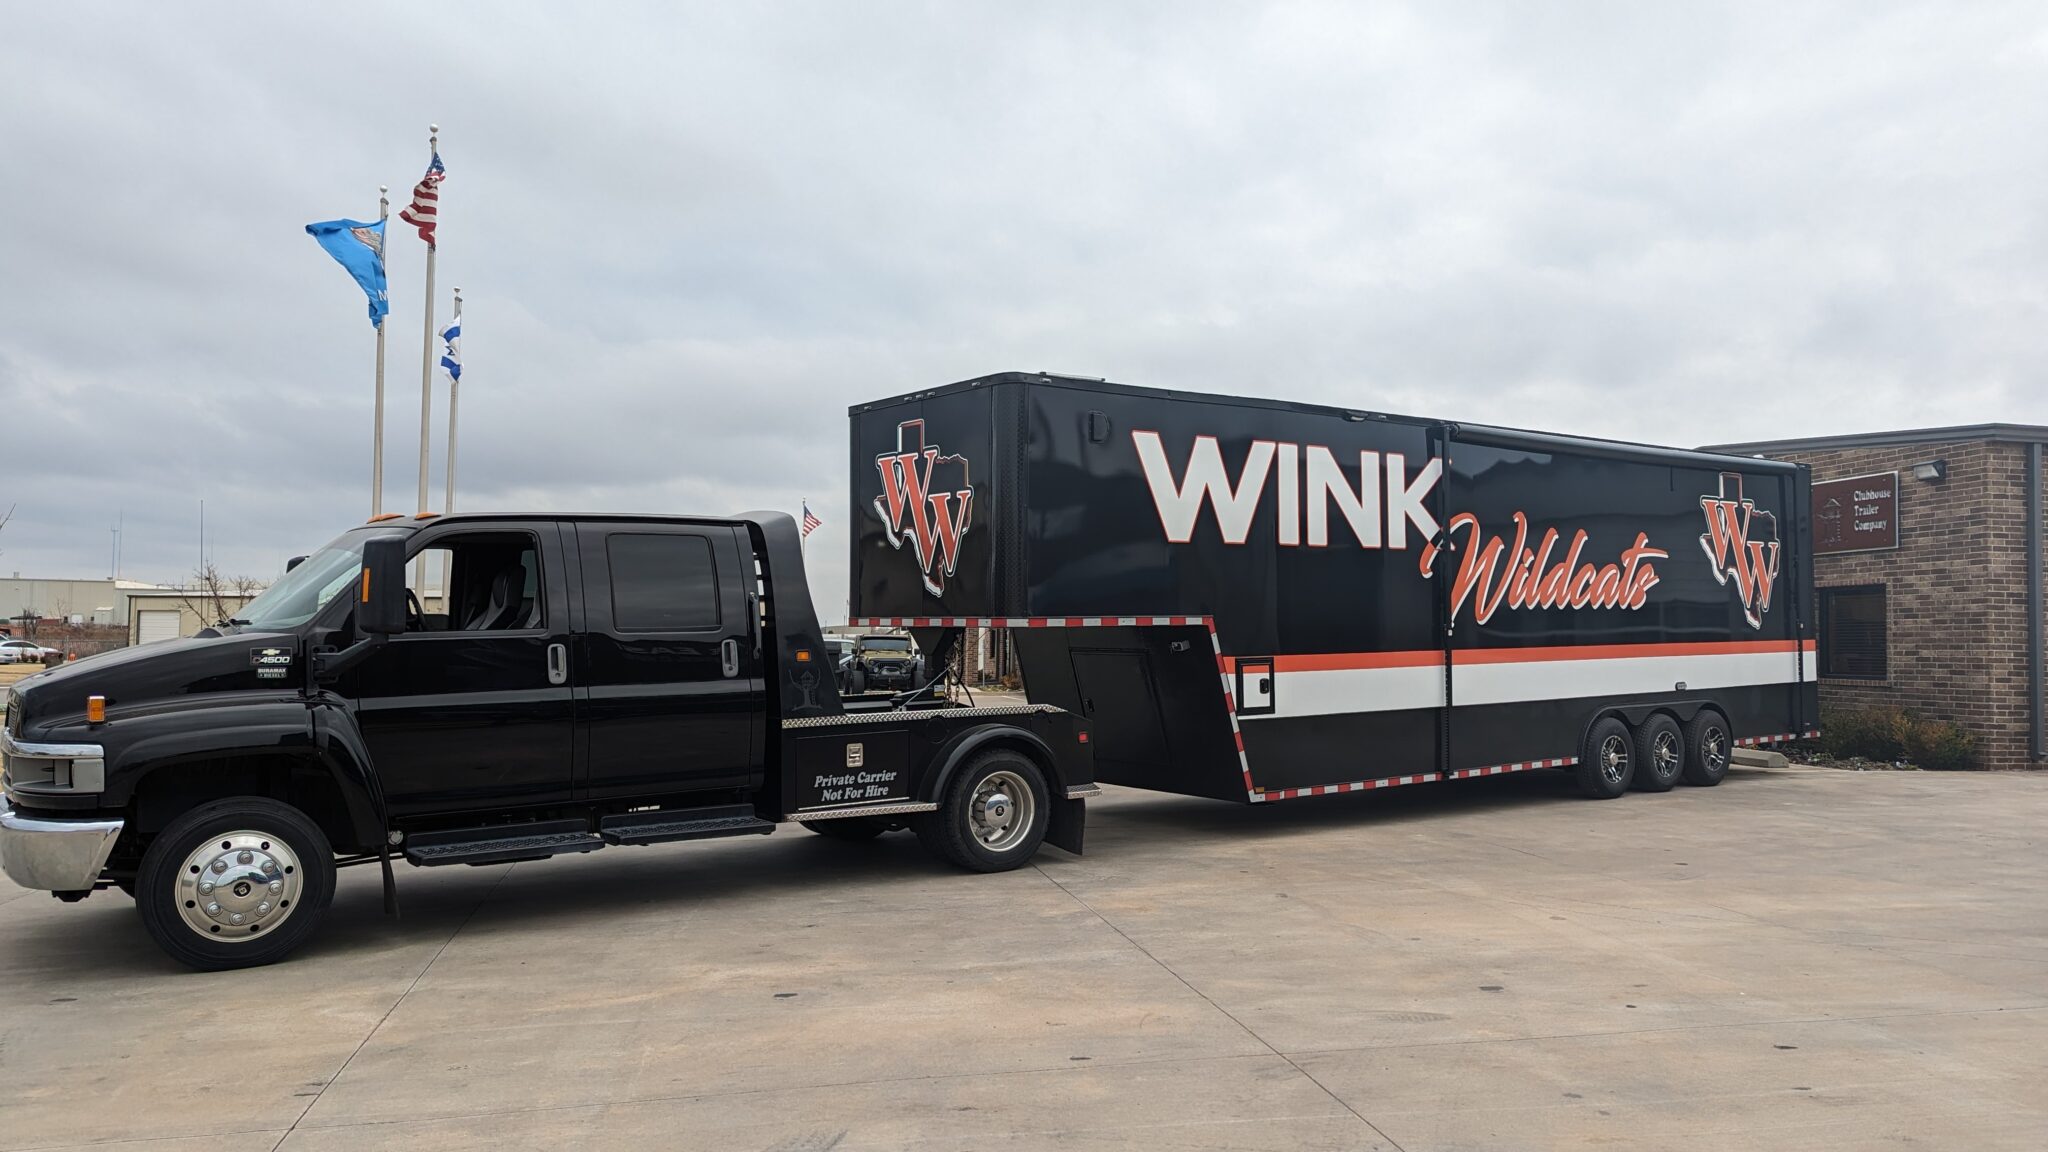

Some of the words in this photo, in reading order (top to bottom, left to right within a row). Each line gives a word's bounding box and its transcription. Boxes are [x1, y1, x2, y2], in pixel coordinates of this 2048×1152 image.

[1132, 430, 1456, 549] WINK
[1853, 490, 1891, 501] Clubhouse
[1854, 504, 1879, 516] Trailer
[1854, 520, 1887, 532] Company
[1420, 511, 1669, 625] Wildcats
[814, 774, 855, 788] Private
[857, 770, 897, 784] Carrier
[821, 789, 843, 802] Not
[844, 787, 864, 799] For
[865, 785, 889, 798] Hire
